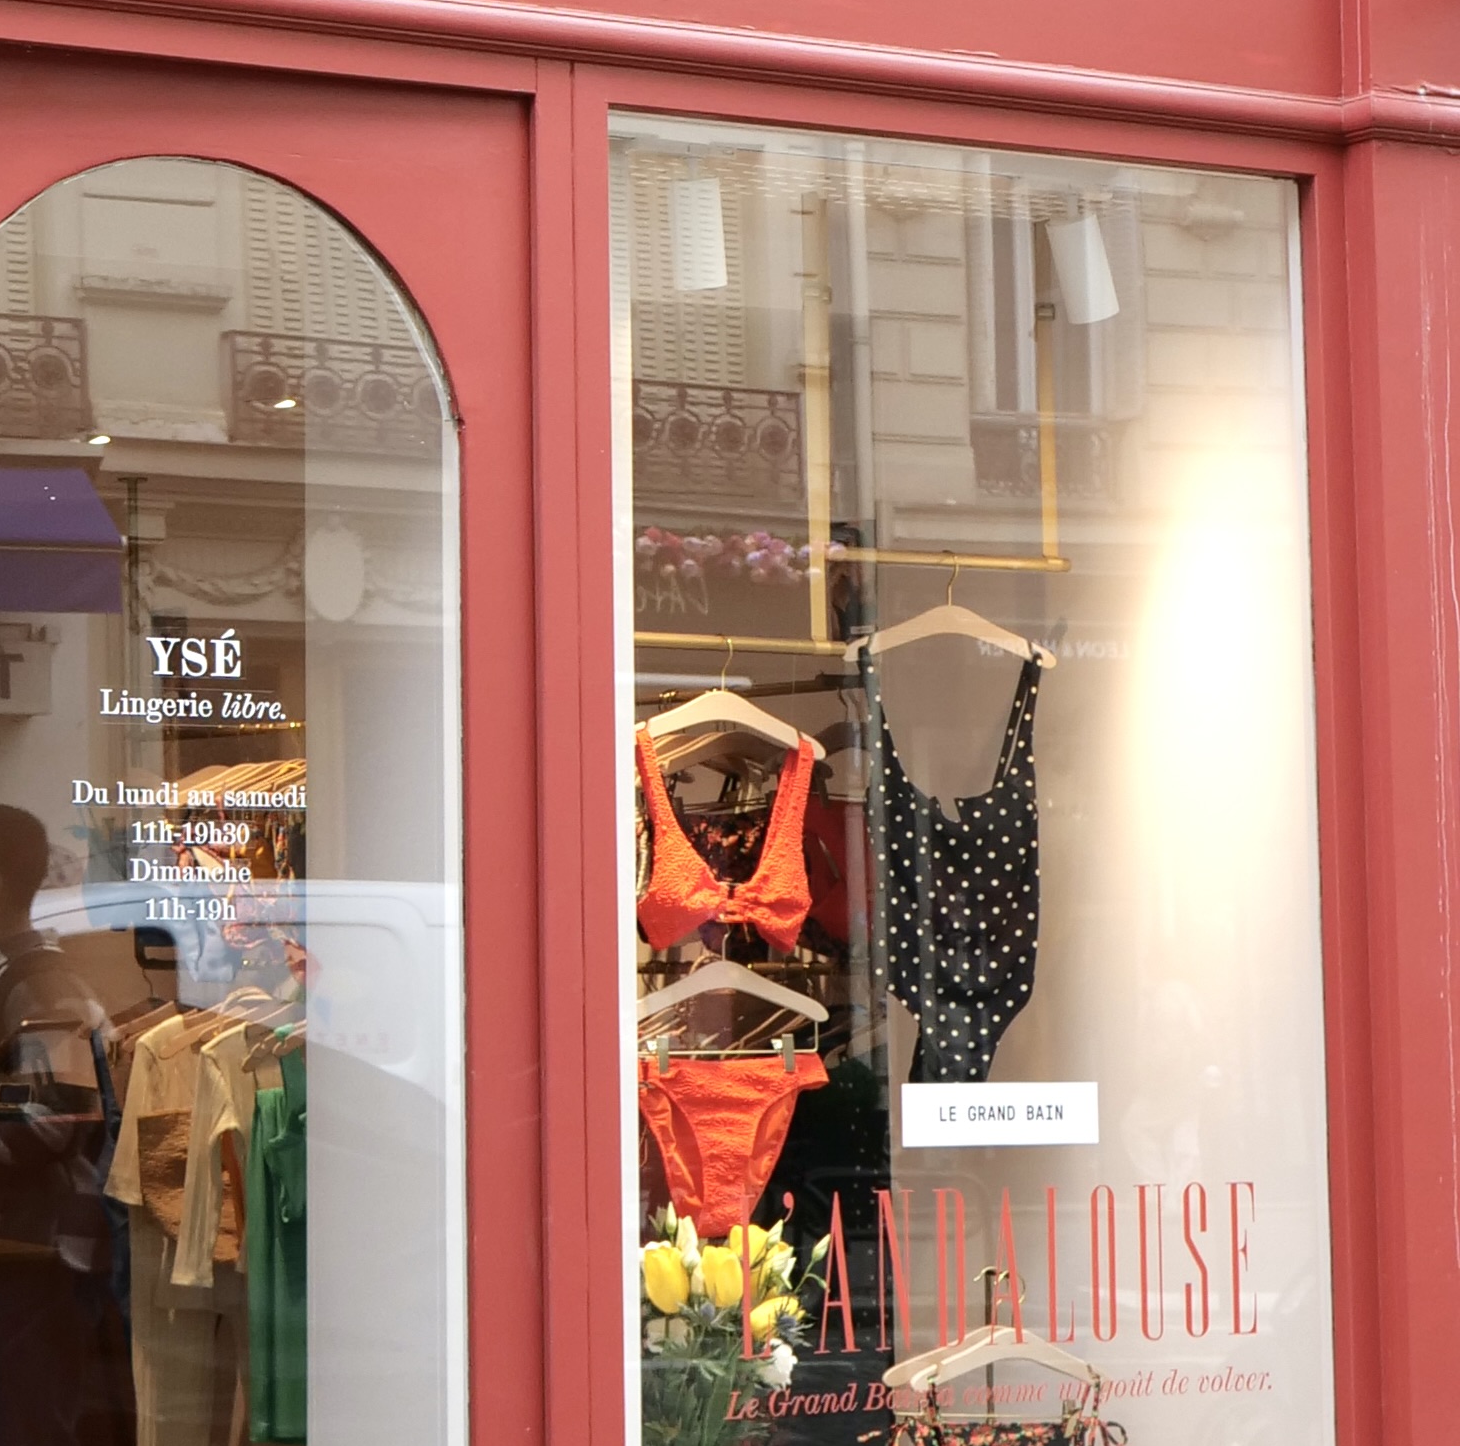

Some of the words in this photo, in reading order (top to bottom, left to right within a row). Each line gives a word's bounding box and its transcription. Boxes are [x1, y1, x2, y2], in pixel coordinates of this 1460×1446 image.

[146, 628, 241, 677] YSÉ
[100, 689, 213, 723] Lingerie
[221, 692, 286, 720] libre.
[72, 780, 109, 804] Du
[117, 781, 179, 806] lundi
[188, 789, 216, 807] au
[224, 785, 307, 808] samedi
[132, 821, 250, 845] 11h-19h30
[129, 858, 251, 883] Dimanche
[145, 898, 236, 921] 11h-19h
[939, 1106, 957, 1122] LE
[968, 1105, 1016, 1122] GRAND
[1026, 1104, 1064, 1121] BAIN
[724, 1390, 759, 1421] Le
[768, 1382, 858, 1417] Grand
[963, 1381, 1047, 1405] comme
[1161, 1369, 1189, 1395] de
[1198, 1366, 1273, 1394] volver.
